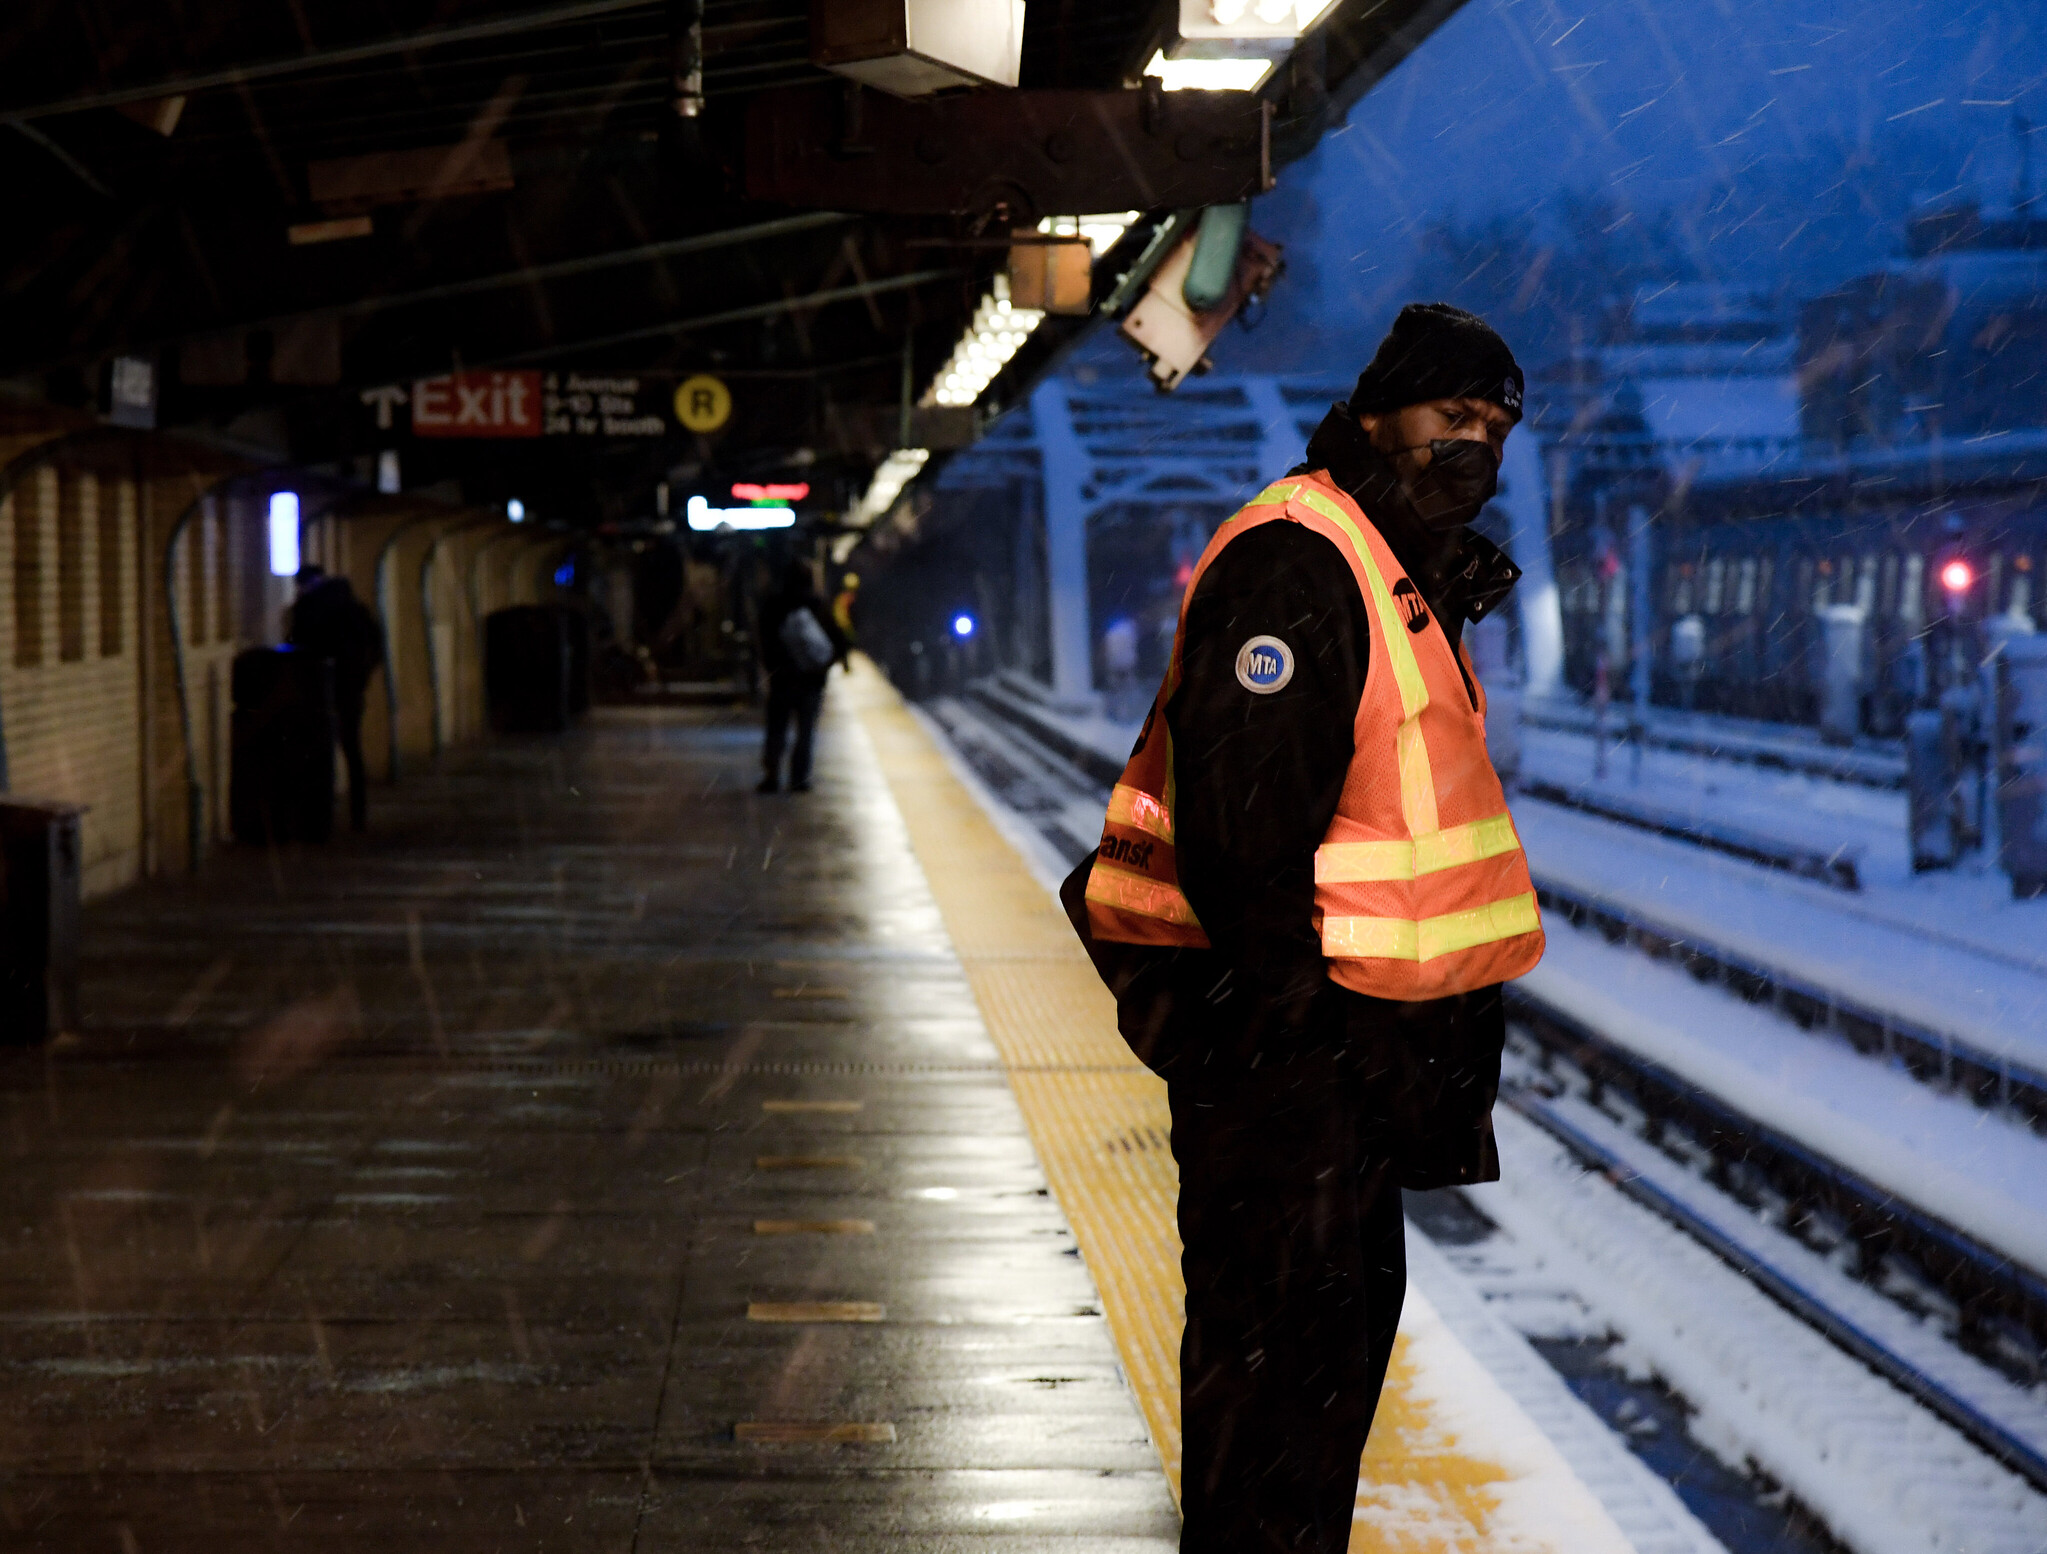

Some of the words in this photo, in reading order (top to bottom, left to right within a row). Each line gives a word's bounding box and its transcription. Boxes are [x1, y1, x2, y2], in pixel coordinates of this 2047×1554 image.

[412, 374, 530, 425] Exit
[691, 389, 715, 417] R
[1244, 652, 1277, 676] MTA
